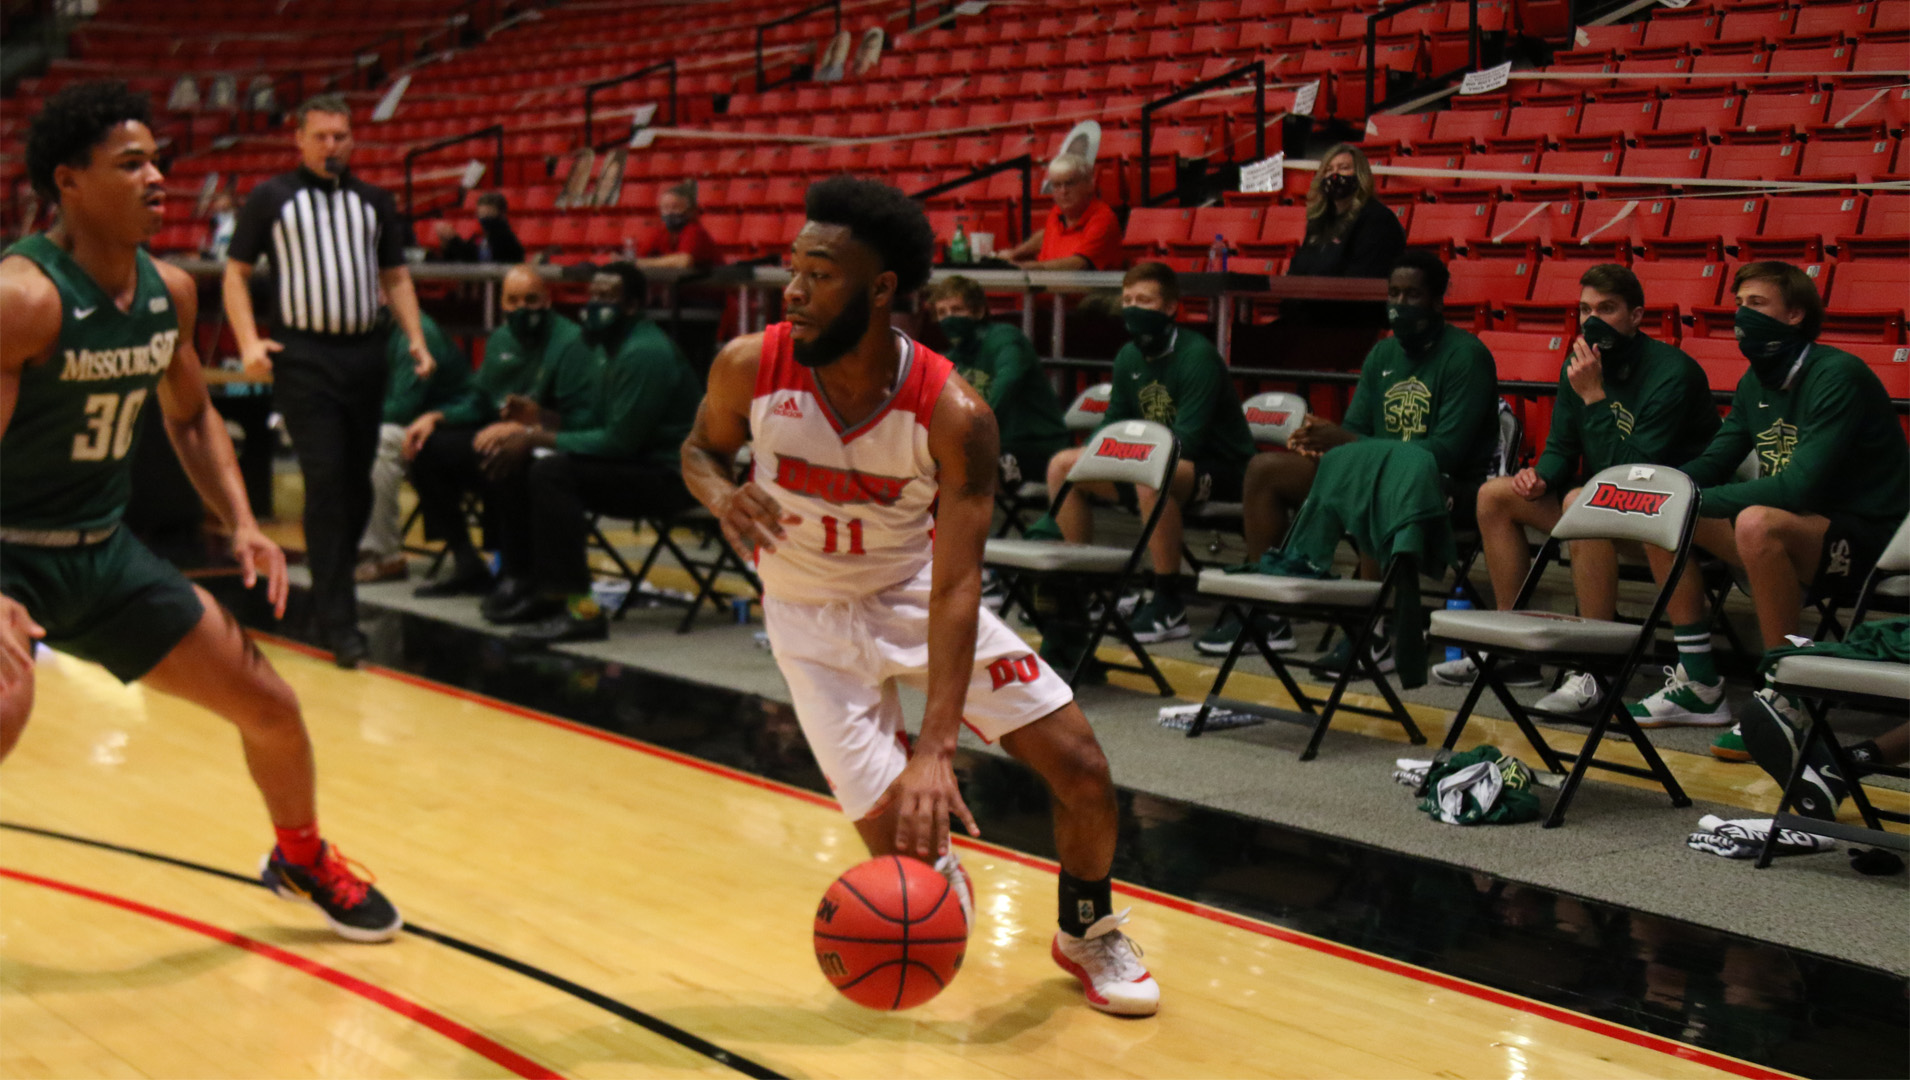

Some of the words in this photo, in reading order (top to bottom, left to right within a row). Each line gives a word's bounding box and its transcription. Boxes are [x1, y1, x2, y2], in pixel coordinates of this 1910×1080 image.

[71, 388, 147, 461] 30
[1094, 437, 1157, 461] DRURY
[775, 454, 915, 506] DRURY
[1586, 482, 1672, 516] DRURY
[821, 515, 866, 555] 11
[985, 653, 1040, 692] DU
